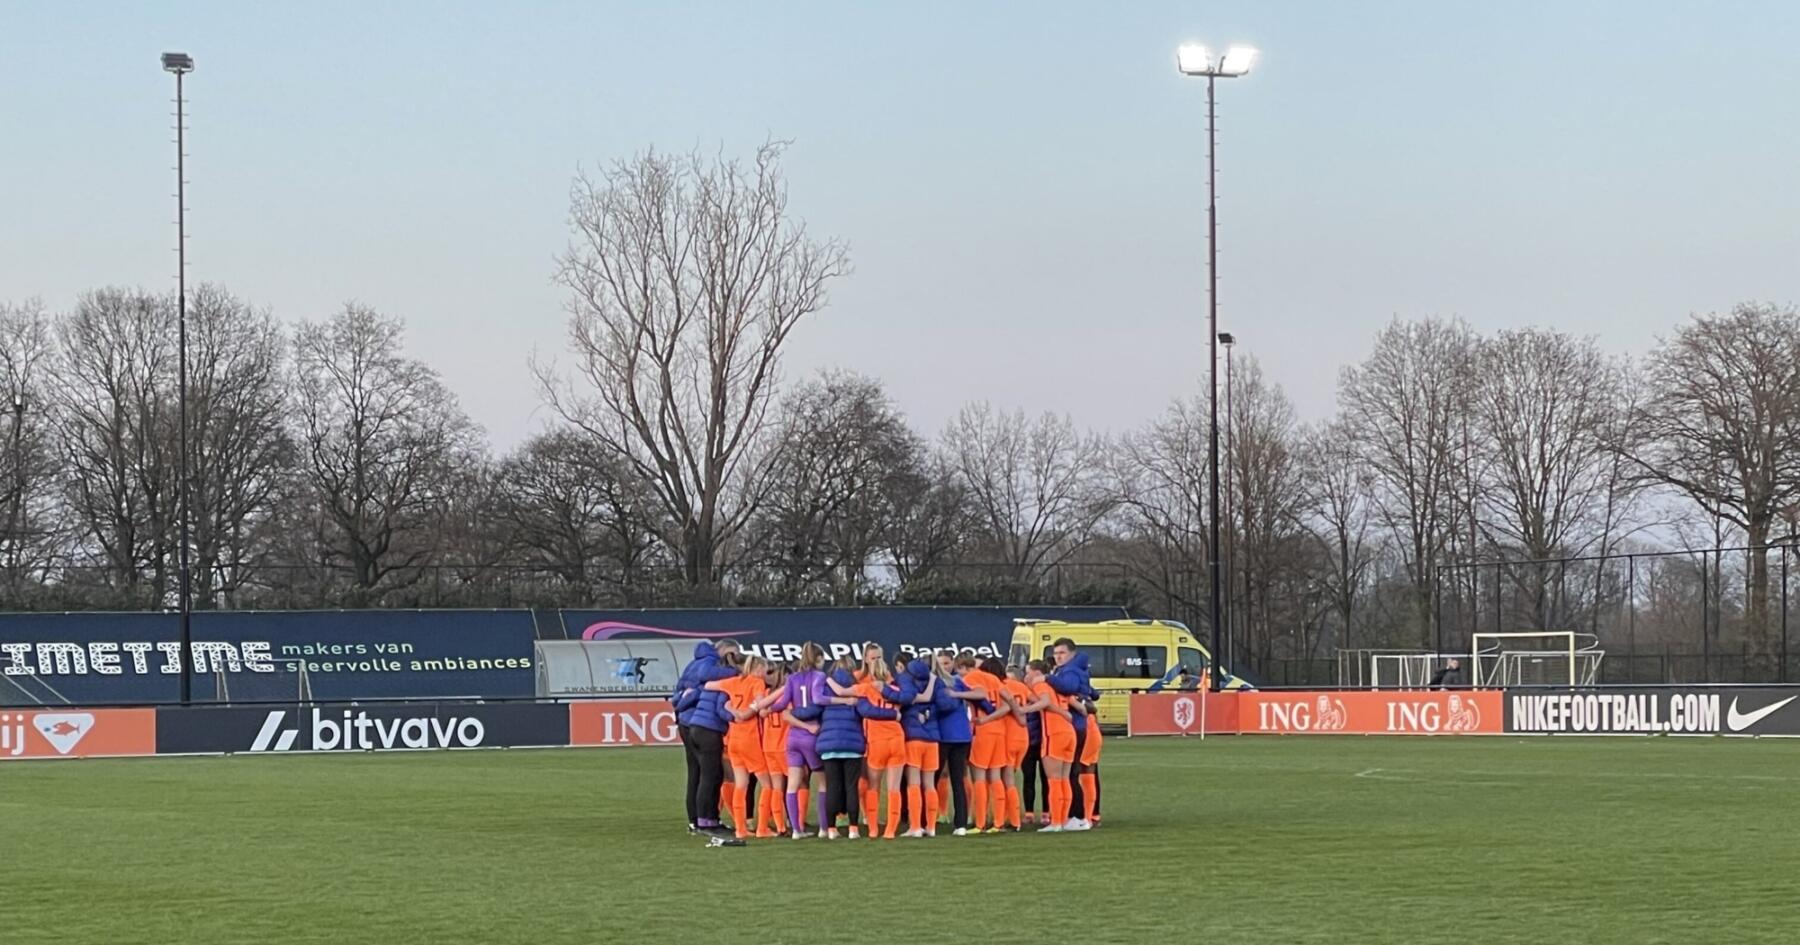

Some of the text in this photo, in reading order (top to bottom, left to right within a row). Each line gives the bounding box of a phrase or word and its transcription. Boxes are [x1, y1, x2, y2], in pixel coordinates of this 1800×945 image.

[282, 641, 414, 655] makers van
[286, 656, 531, 672] seervolle ambiances
[800, 685, 807, 708] 1
[601, 711, 678, 743] ING
[1259, 702, 1311, 731] ING
[1386, 702, 1441, 732] ING
[1512, 694, 1720, 732] NIKEFOOTBALL.COM
[312, 708, 485, 750] bitvavo
